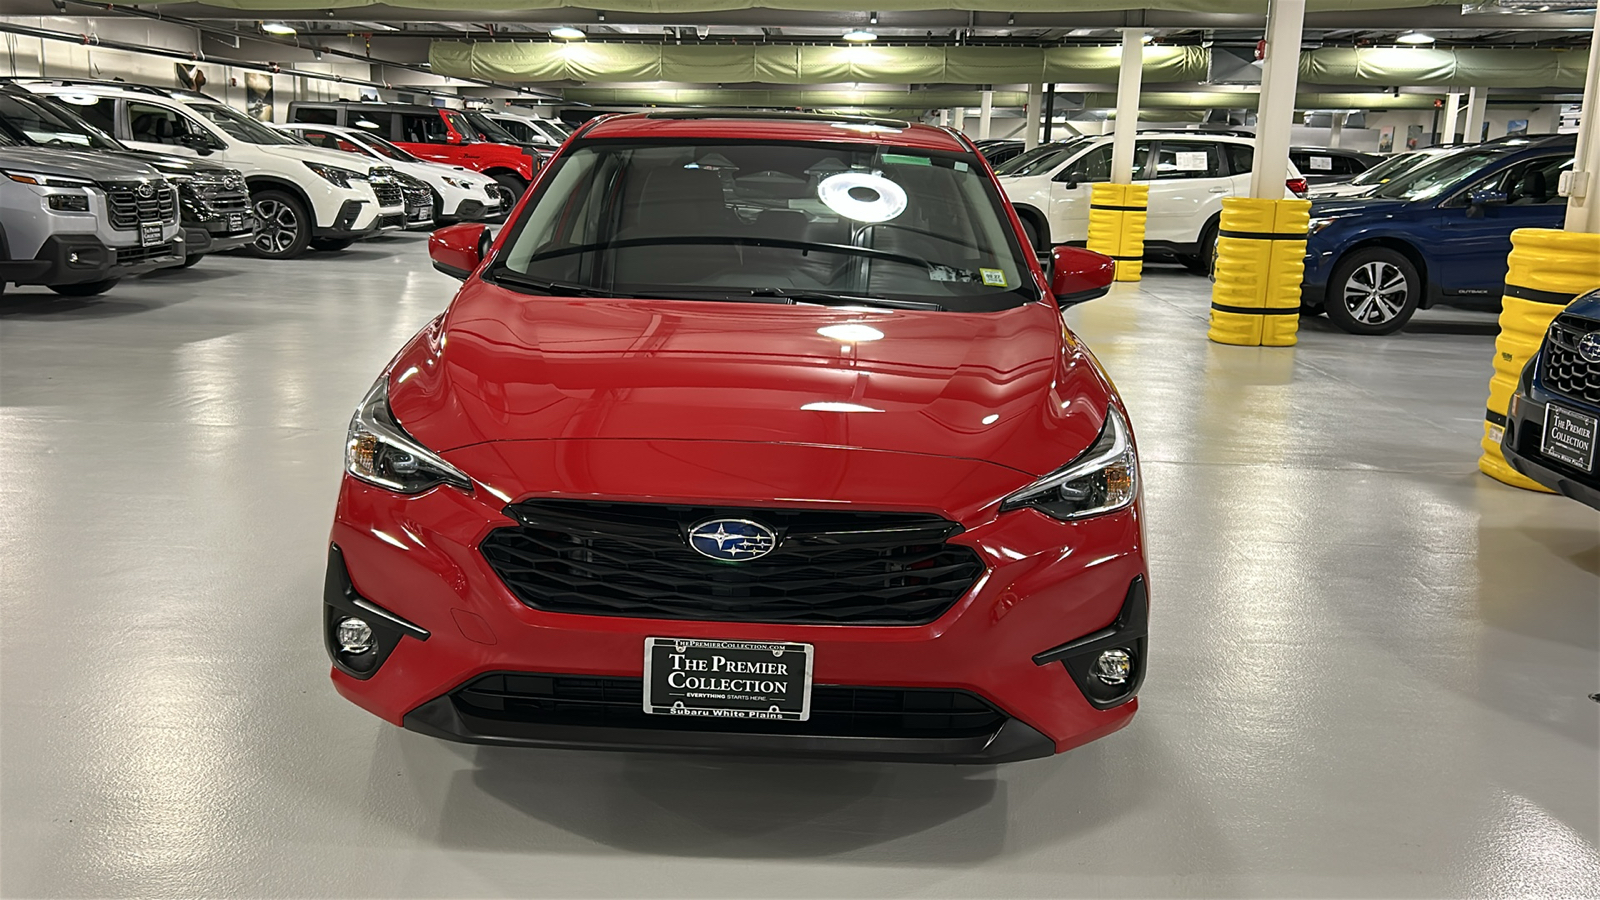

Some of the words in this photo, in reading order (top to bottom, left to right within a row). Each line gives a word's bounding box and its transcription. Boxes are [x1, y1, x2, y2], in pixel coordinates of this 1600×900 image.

[1553, 415, 1566, 430] THE
[1565, 419, 1591, 439] PREMIER
[1551, 427, 1590, 451] COLLECTION
[668, 653, 708, 671] THE
[711, 655, 788, 676] PREMIER
[668, 671, 788, 694] COLLECTION
[670, 707, 709, 716] Subaru
[712, 709, 745, 718] White
[749, 710, 783, 719] Plains
